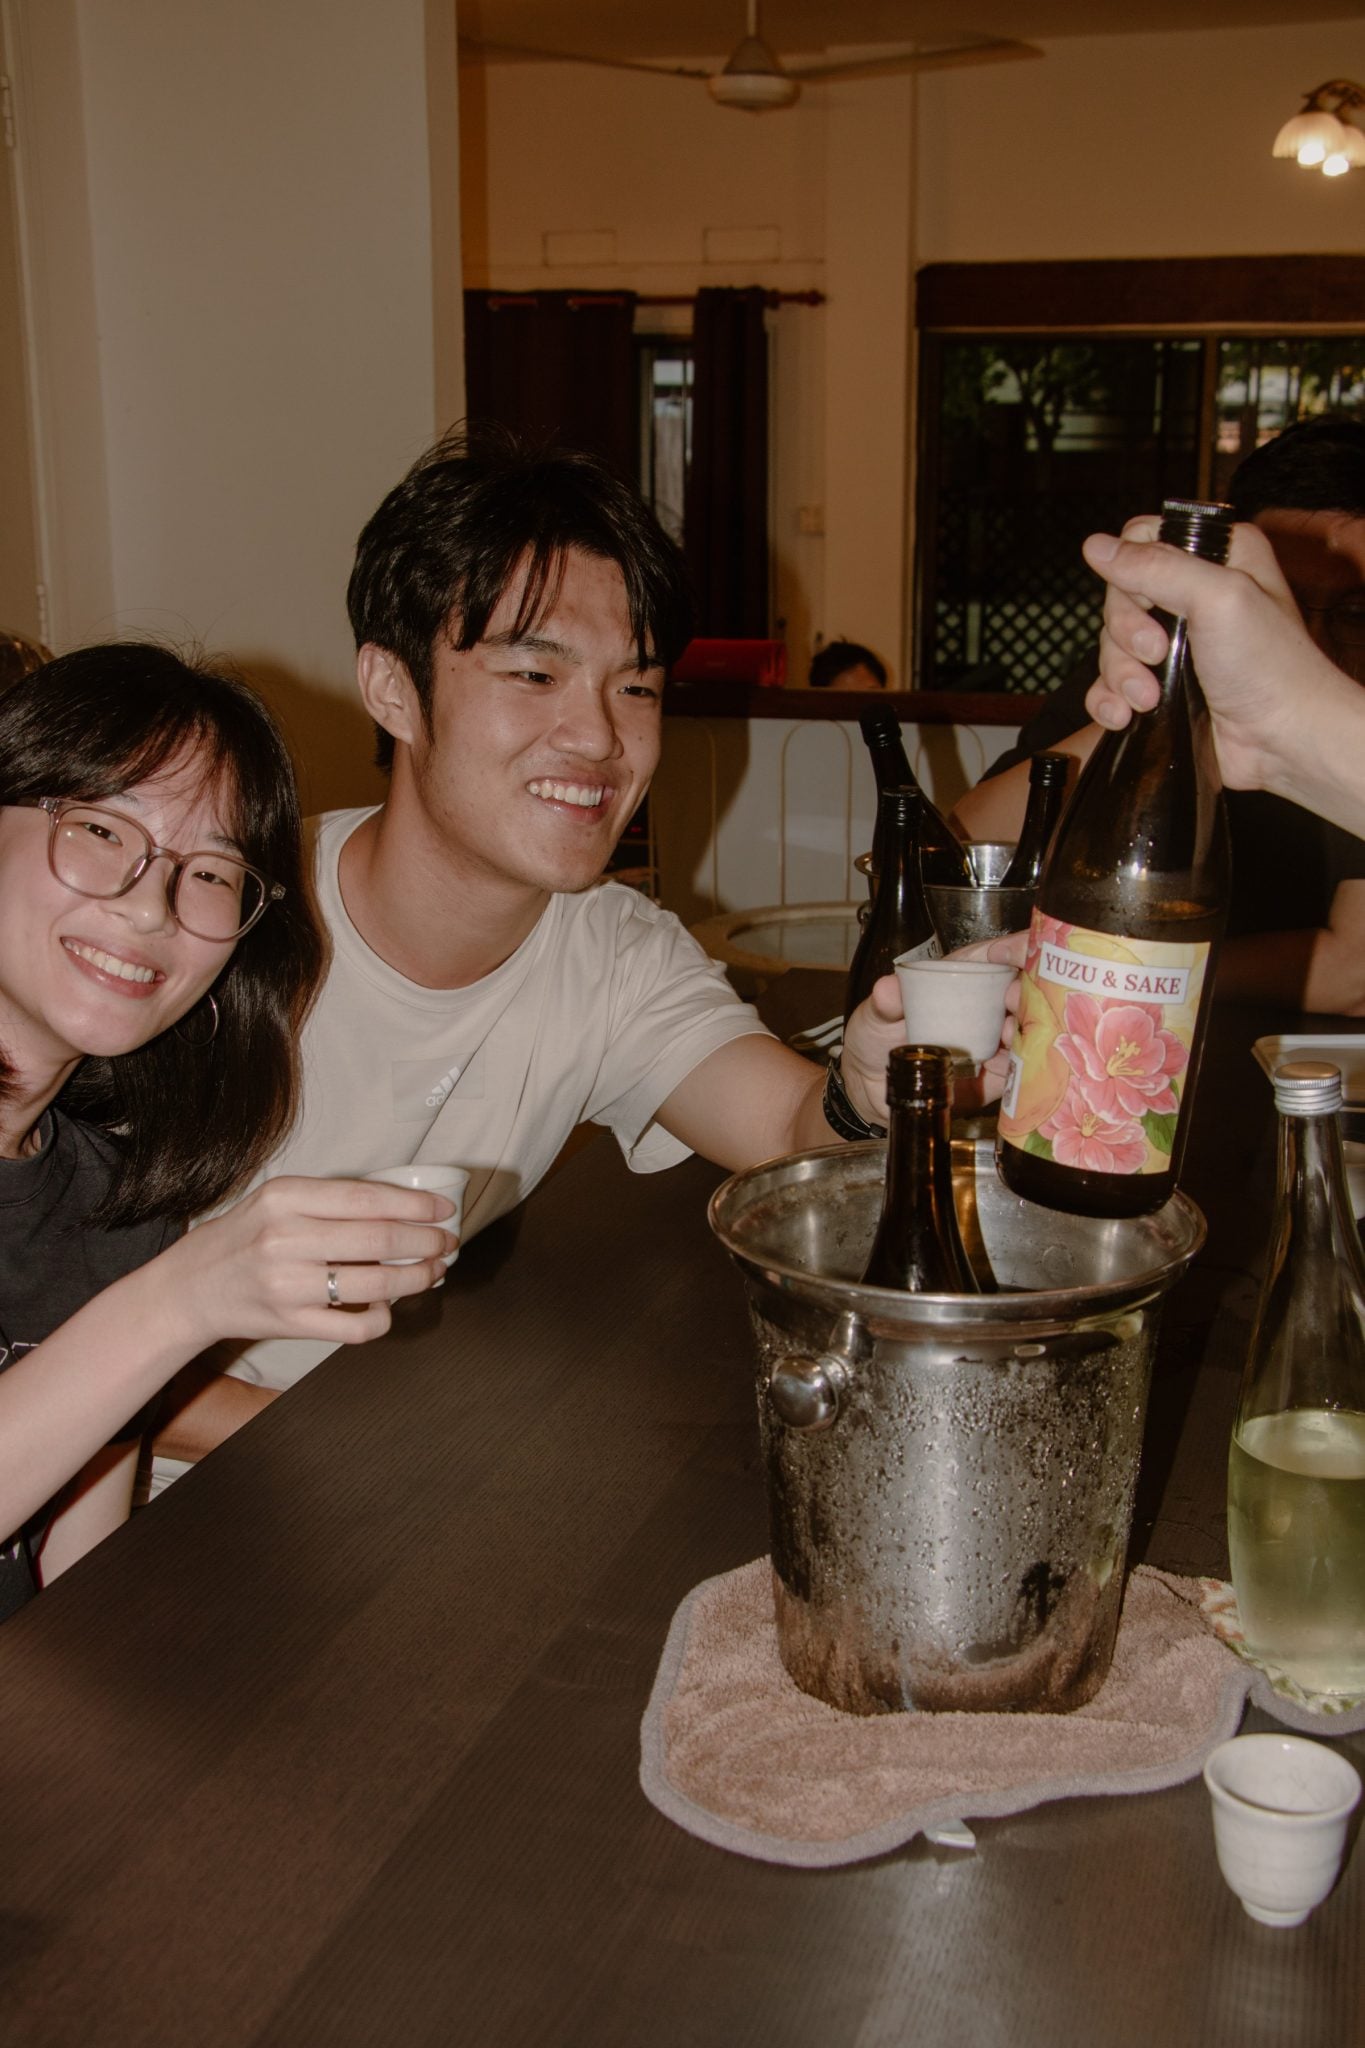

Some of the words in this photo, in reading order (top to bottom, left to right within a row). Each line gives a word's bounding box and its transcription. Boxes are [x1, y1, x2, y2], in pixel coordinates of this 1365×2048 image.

[1045, 952, 1098, 984] YUZU
[1102, 970, 1118, 989] &
[1124, 973, 1181, 995] SAKE
